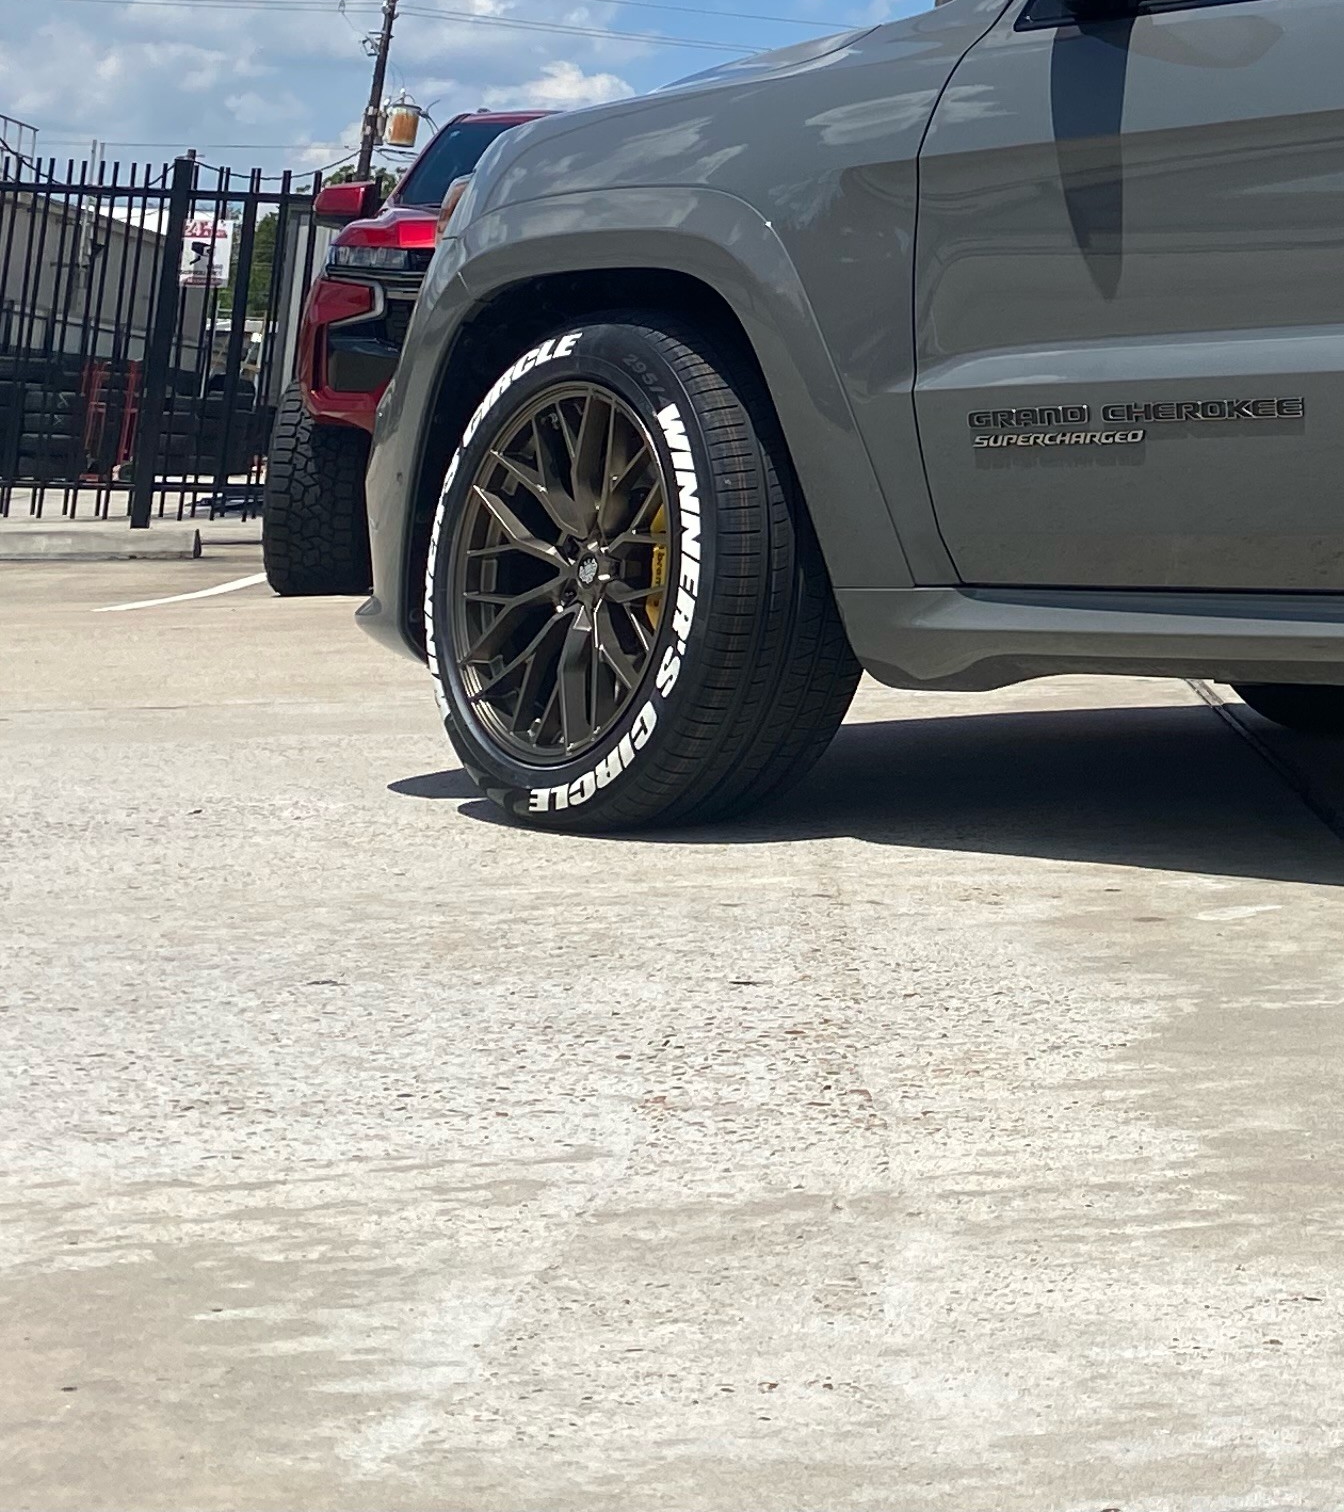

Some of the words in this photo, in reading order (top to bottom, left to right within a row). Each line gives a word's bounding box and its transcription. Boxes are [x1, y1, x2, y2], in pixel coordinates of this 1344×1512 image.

[463, 332, 583, 448] CIRCLE
[967, 403, 1090, 429] GRAND
[1101, 396, 1305, 424] CHEROKEE
[973, 429, 1146, 449] SUPERCHARGED
[655, 403, 701, 697] WINNER'S
[529, 700, 658, 812] CIRCLE
